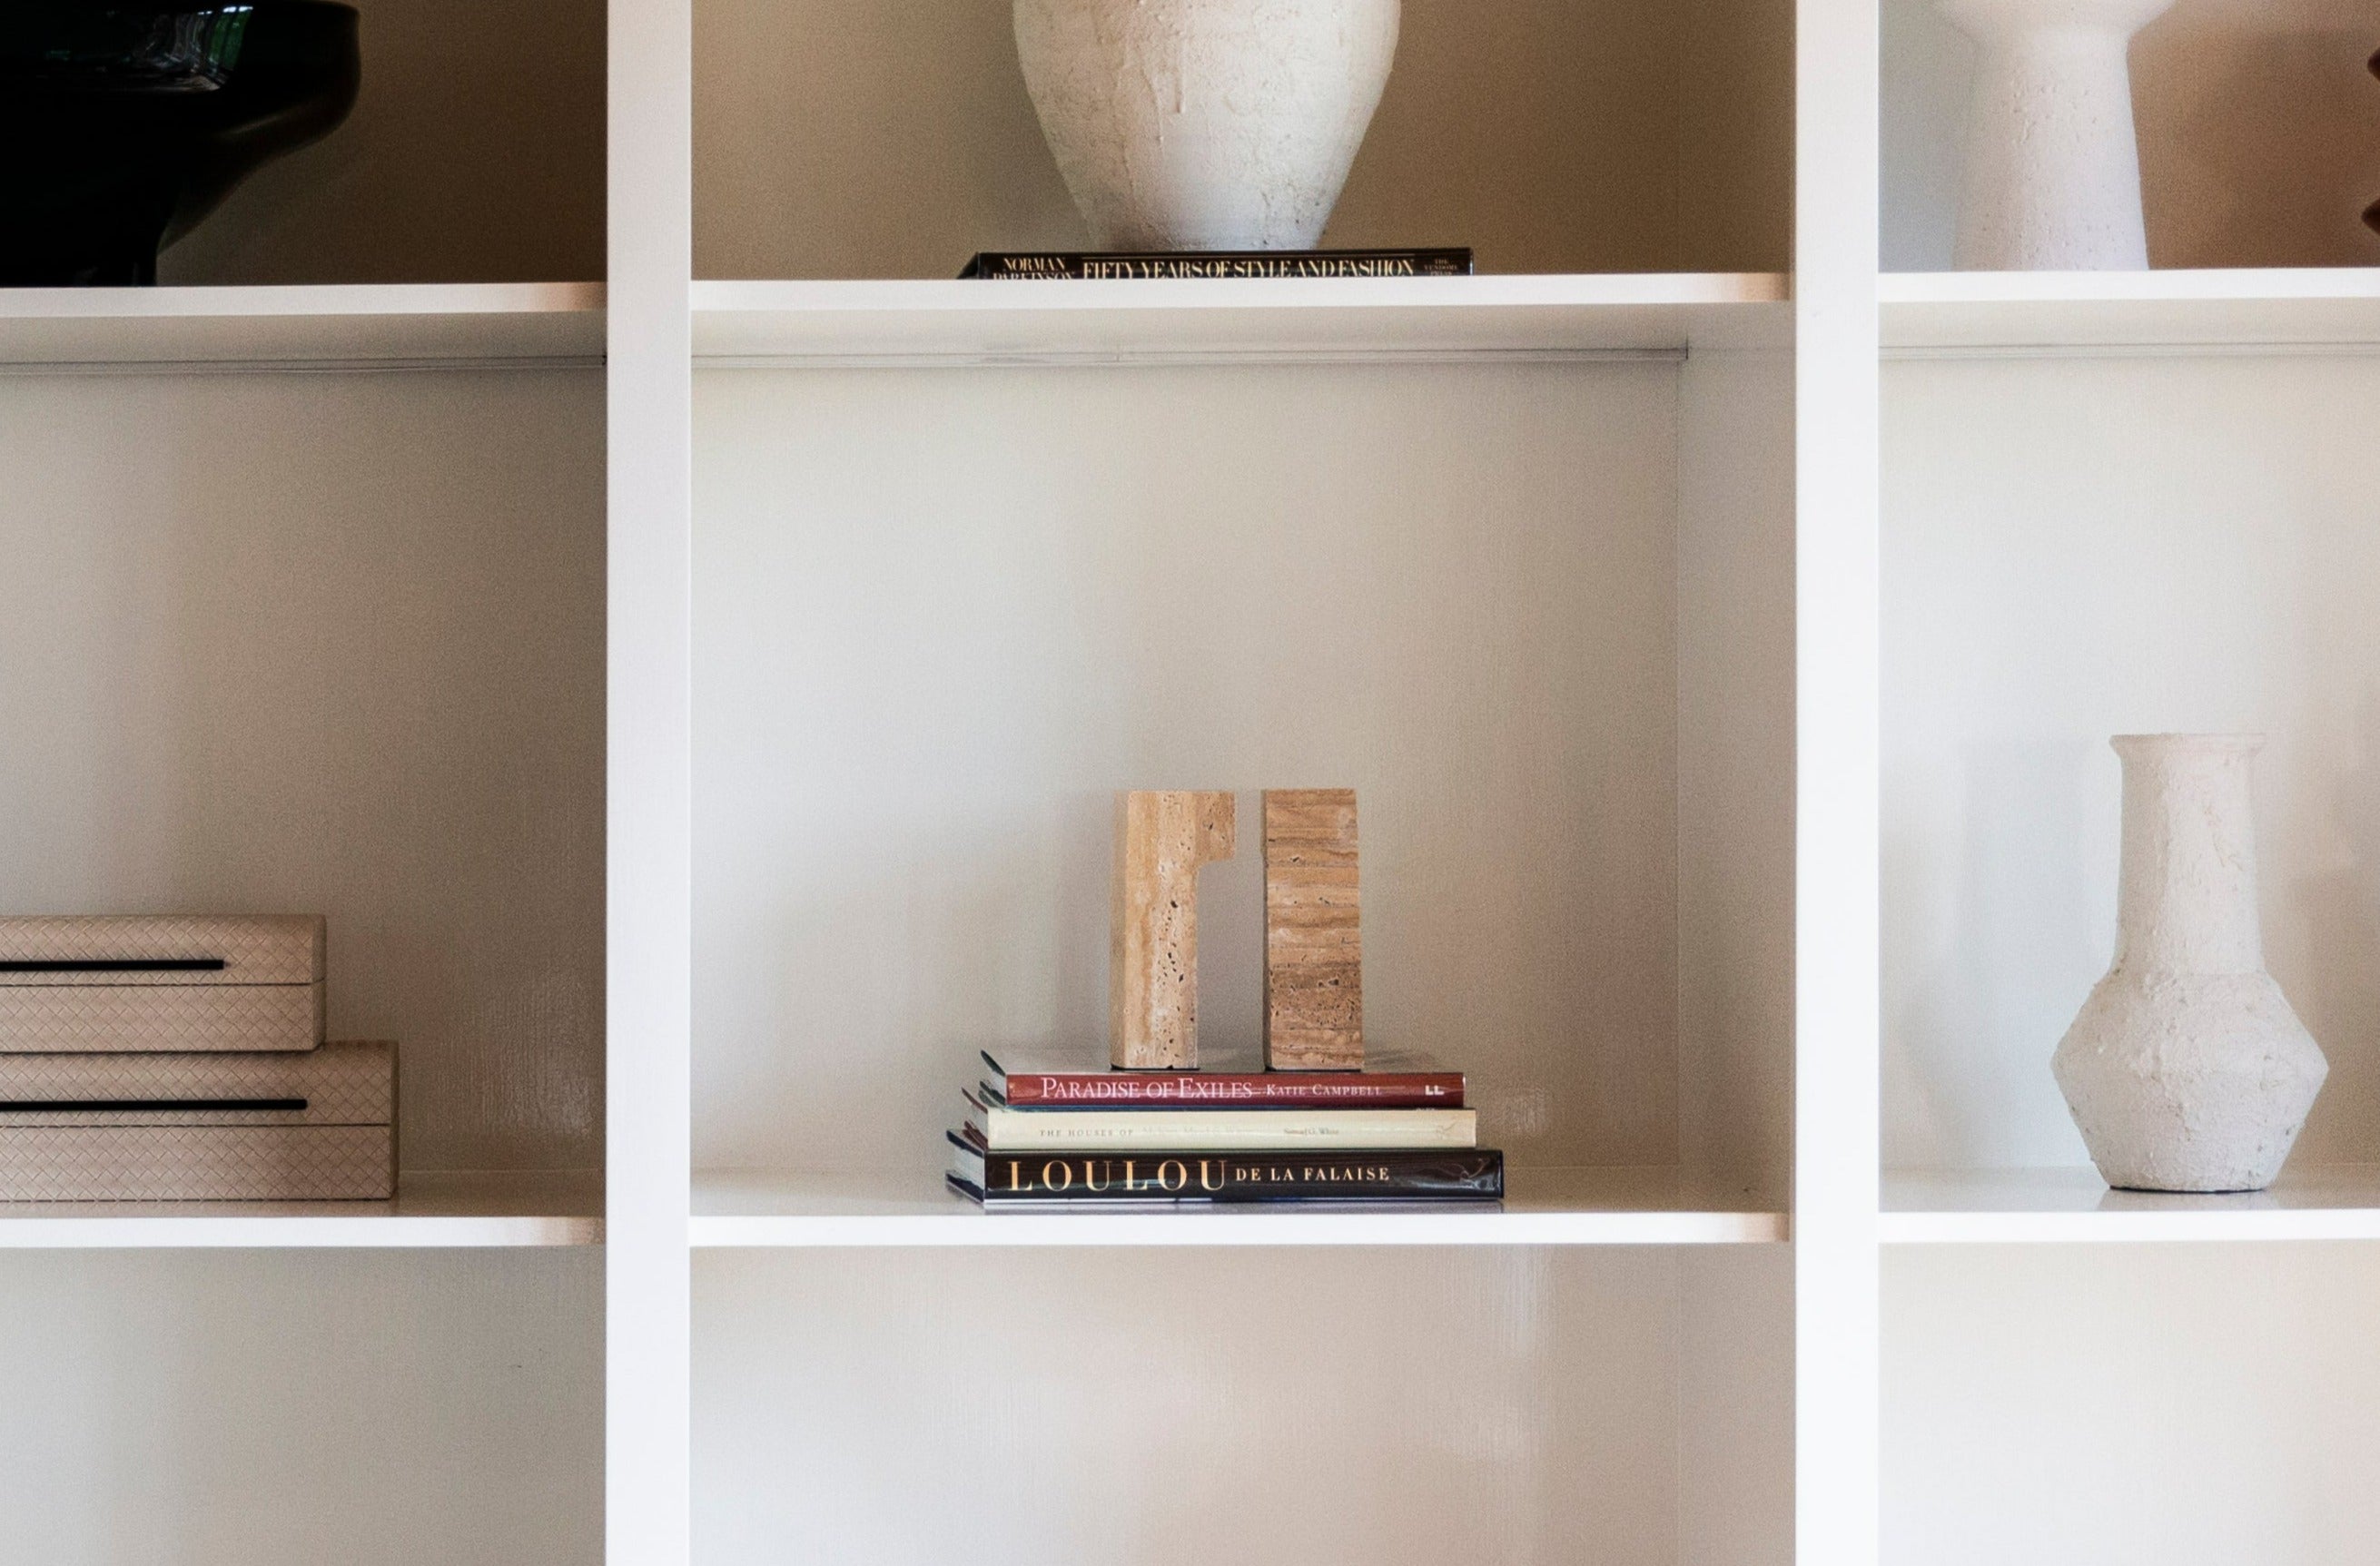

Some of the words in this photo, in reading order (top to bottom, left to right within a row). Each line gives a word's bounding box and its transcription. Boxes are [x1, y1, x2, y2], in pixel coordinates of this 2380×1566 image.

[1002, 257, 1065, 271] NORMAN
[1083, 261, 1135, 278] FIFTY
[1141, 261, 1203, 278] YEARS
[1206, 261, 1230, 278] OF
[1233, 261, 1291, 277] STYLE
[1293, 260, 1336, 277] AND
[1339, 260, 1415, 277] FASHION
[1041, 1077, 1140, 1098] PARADISE
[1146, 1081, 1174, 1098] OF
[1178, 1078, 1253, 1098] EXILES
[1266, 1084, 1307, 1096] KATIE
[1311, 1084, 1383, 1096] CAMPBELL
[1006, 1160, 1227, 1192] LOULOU
[1236, 1168, 1261, 1181] DE
[1270, 1168, 1296, 1181] LA
[1305, 1167, 1390, 1181] FALAISE
